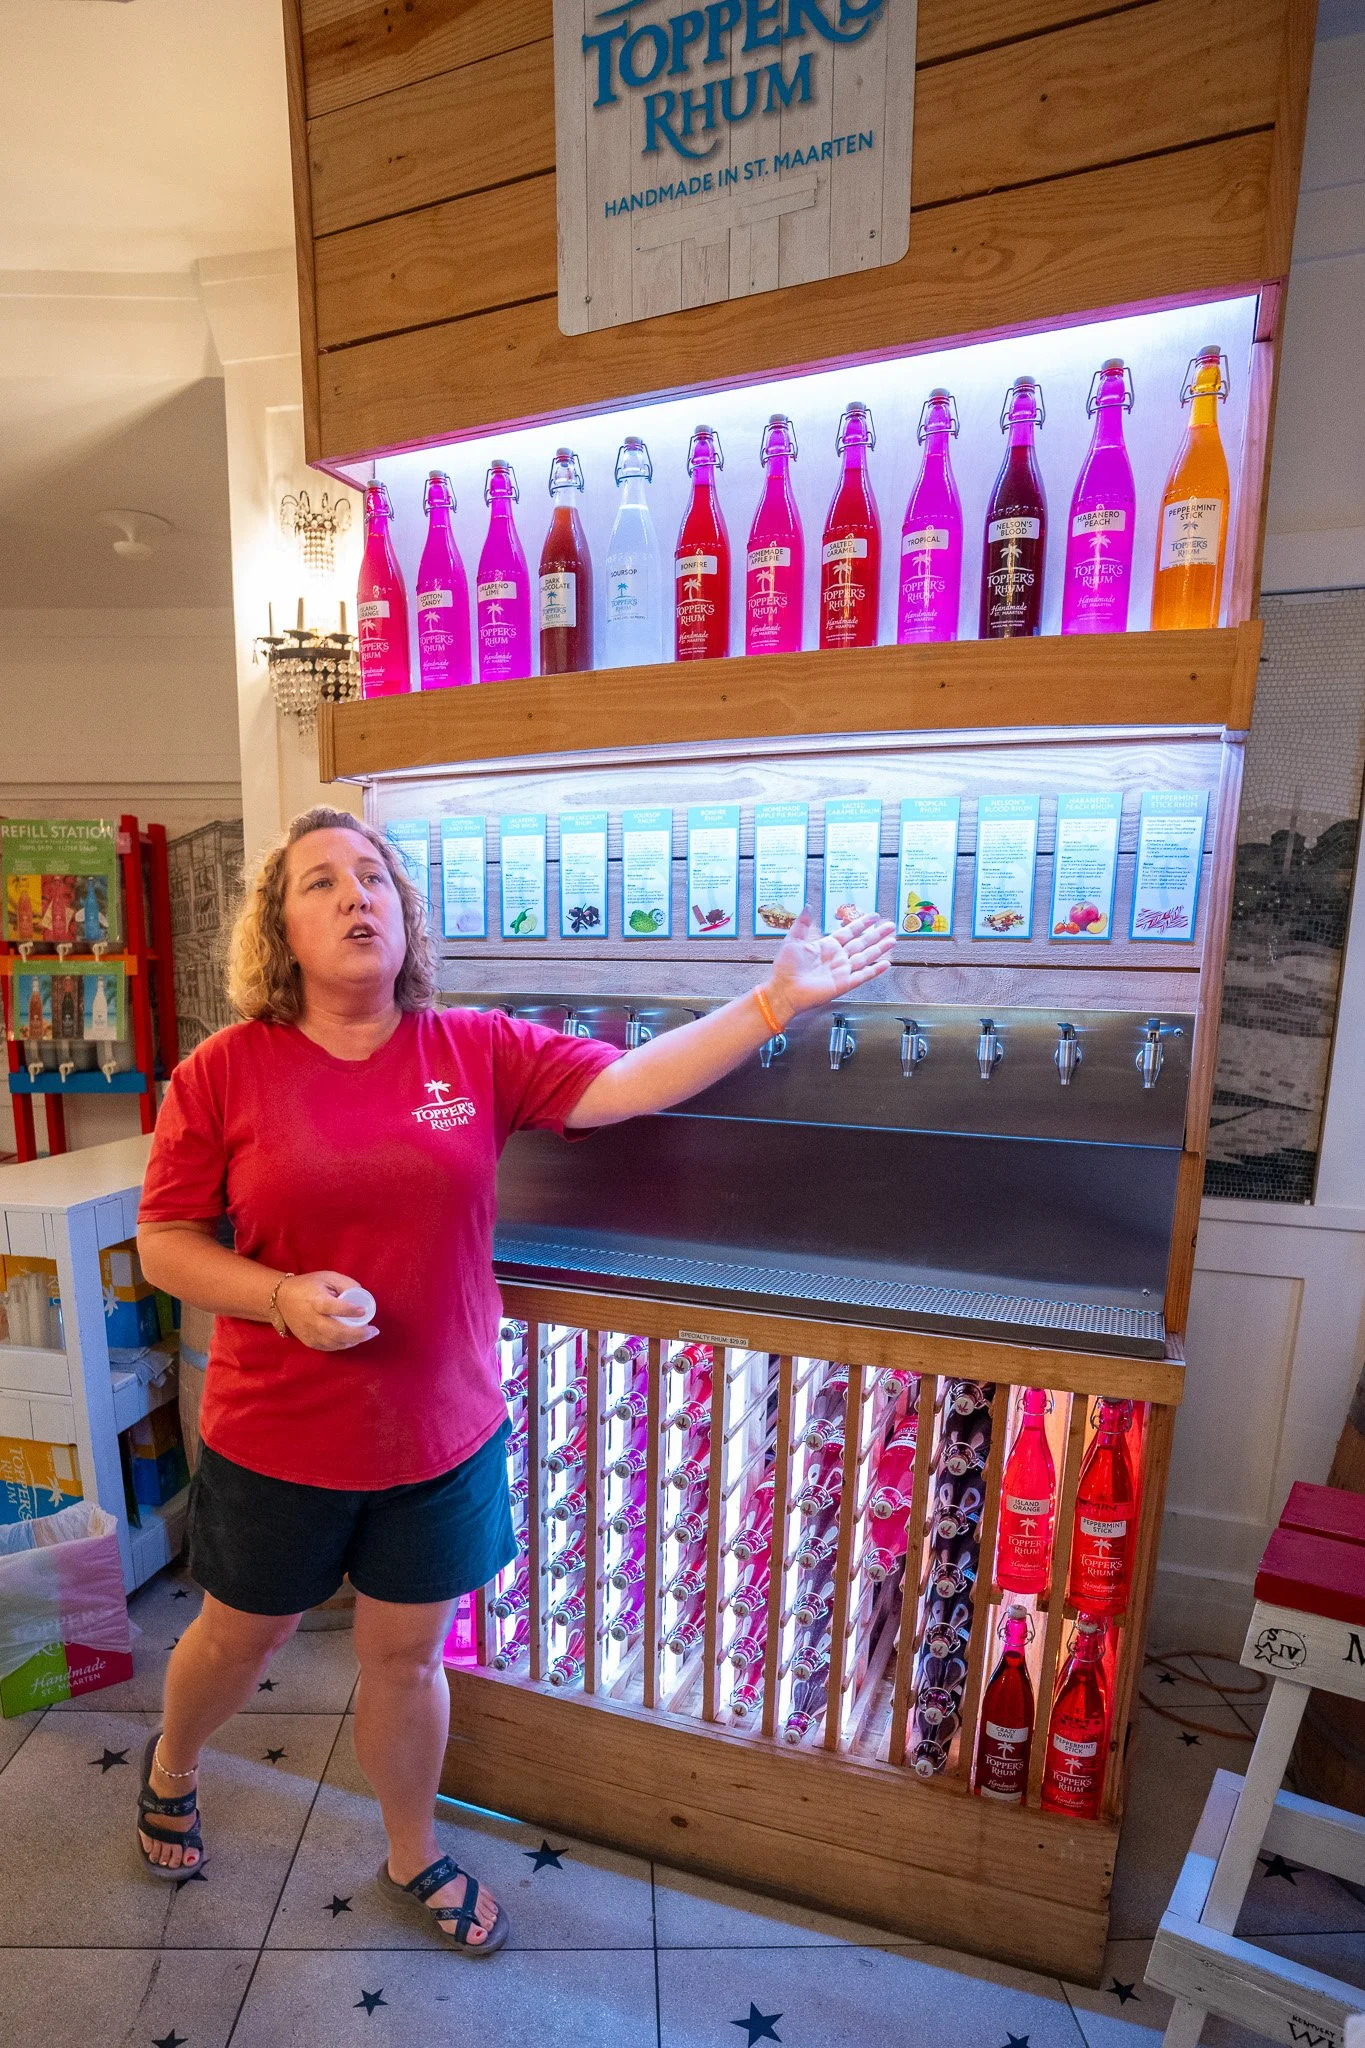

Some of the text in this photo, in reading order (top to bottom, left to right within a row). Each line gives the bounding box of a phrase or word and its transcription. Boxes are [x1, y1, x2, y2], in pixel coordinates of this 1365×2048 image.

[582, 0, 886, 109] TOPPER
[641, 53, 814, 160] RHUM
[604, 130, 874, 219] HANDMADE IN ST. MAARTEN
[1077, 511, 1120, 523] HABANERO
[1168, 505, 1217, 517] PEPPERMINT
[1180, 512, 1203, 520] STICK
[996, 521, 1033, 530] NELSON'S
[1084, 519, 1111, 528] PEACH
[1000, 528, 1028, 536] BLOOD
[829, 541, 854, 550] SALTED
[907, 535, 941, 546] TROPICAL
[1171, 540, 1208, 551] TOPPER'S
[749, 549, 784, 559] HOMEMADE
[826, 547, 857, 557] CARAMEL
[681, 562, 708, 571] BONFIRE
[751, 556, 768, 566] APPLE
[611, 569, 638, 578] SOURSOP
[1073, 564, 1123, 579] TOPPER'S
[987, 573, 1035, 588] TOPPER'S
[1082, 576, 1114, 589] RHUM
[823, 588, 866, 603] TOPPER'S
[995, 584, 1025, 597] RHUM
[421, 599, 441, 608] CANDY
[748, 596, 788, 610] TOPPER'S
[907, 592, 935, 604] RHUM
[1077, 594, 1116, 608] Handmade
[676, 604, 715, 618] TOPPER'S
[829, 600, 856, 611] RHUM
[990, 602, 1028, 616] Handmade
[752, 607, 778, 619] RHUM
[904, 608, 938, 623] Handmade
[680, 614, 706, 626] RHUM
[826, 616, 859, 630] Handmade
[480, 627, 517, 639] TOPPER'S
[750, 623, 781, 637] Handmade
[485, 637, 509, 647] RHUM
[678, 631, 709, 644] Handmade
[360, 642, 390, 653] OPPER'S
[423, 644, 446, 655] RHUM
[361, 652, 381, 662] RHUM
[1150, 794, 1200, 802] PEPPERMINT
[1, 825, 114, 839] REFILL STATION
[411, 1102, 476, 1123] TOPPER'S
[430, 1115, 469, 1132] RHUM
[680, 1332, 710, 1340] SPECIALTY
[711, 1335, 730, 1343] RHUM:
[0, 1460, 18, 1504] RHUM
[9, 1446, 33, 1521] TOPPER'S
[1013, 1504, 1041, 1512] ORANGE
[1083, 1518, 1124, 1528] PEPPERMINT
[1093, 1526, 1113, 1534] STICK
[1008, 1536, 1046, 1548] TOPPER
[1014, 1547, 1040, 1557] RHUM
[1081, 1554, 1123, 1571] TOPPER'S
[1087, 1567, 1114, 1578] RHUM
[1267, 1628, 1279, 1641] S
[30, 1656, 107, 1696] Handmade
[58, 1673, 101, 1691] MAARTEN
[996, 1726, 1017, 1734] CRAZY
[1055, 1736, 1095, 1749] PEPPERMINT
[1064, 1745, 1083, 1754] STICK
[985, 1754, 1024, 1771] TOPPER'S
[991, 1766, 1016, 1777] RHUM
[1052, 1770, 1093, 1787] TOPPER'S
[1058, 1782, 1084, 1793] RHUM
[1292, 2015, 1335, 2038] KENTUCKY
